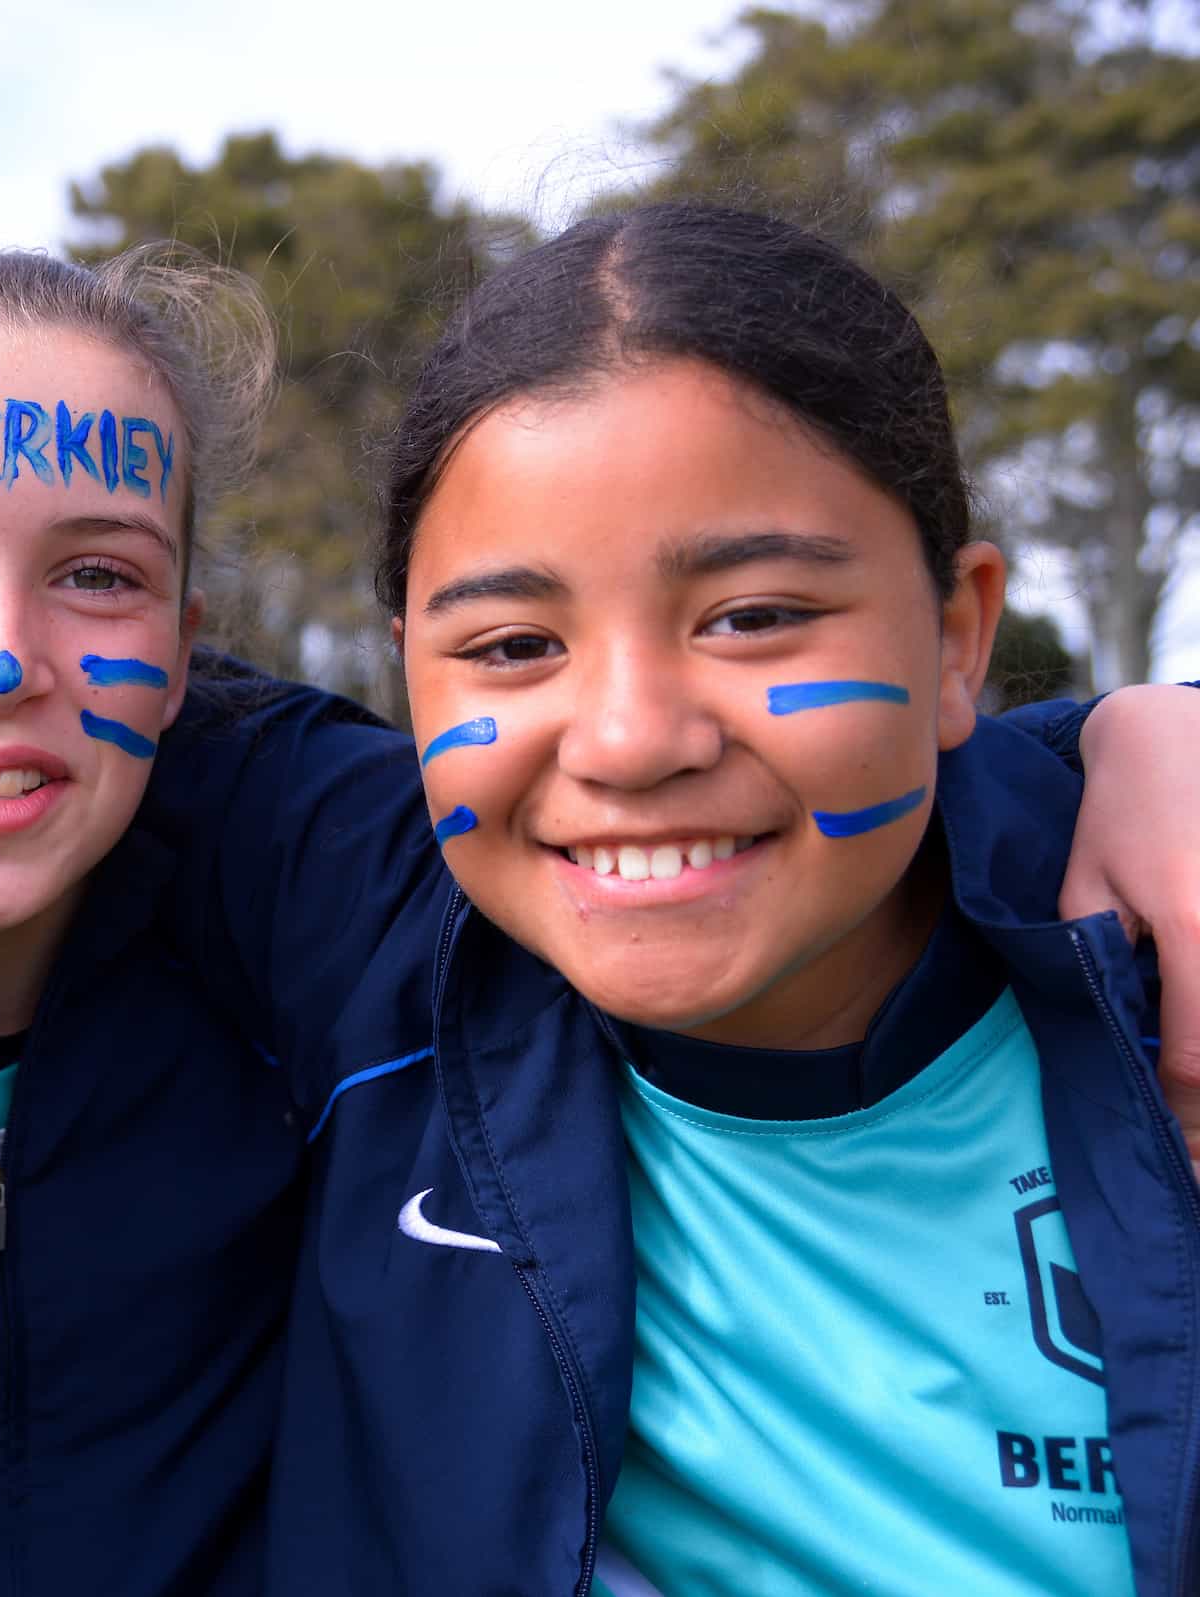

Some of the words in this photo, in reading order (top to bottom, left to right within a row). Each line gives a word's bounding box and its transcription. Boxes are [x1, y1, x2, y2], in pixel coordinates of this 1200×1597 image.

[1009, 1166, 1052, 1195] TAKE
[984, 1292, 1010, 1305] EST.
[1051, 1502, 1122, 1526] Normal
